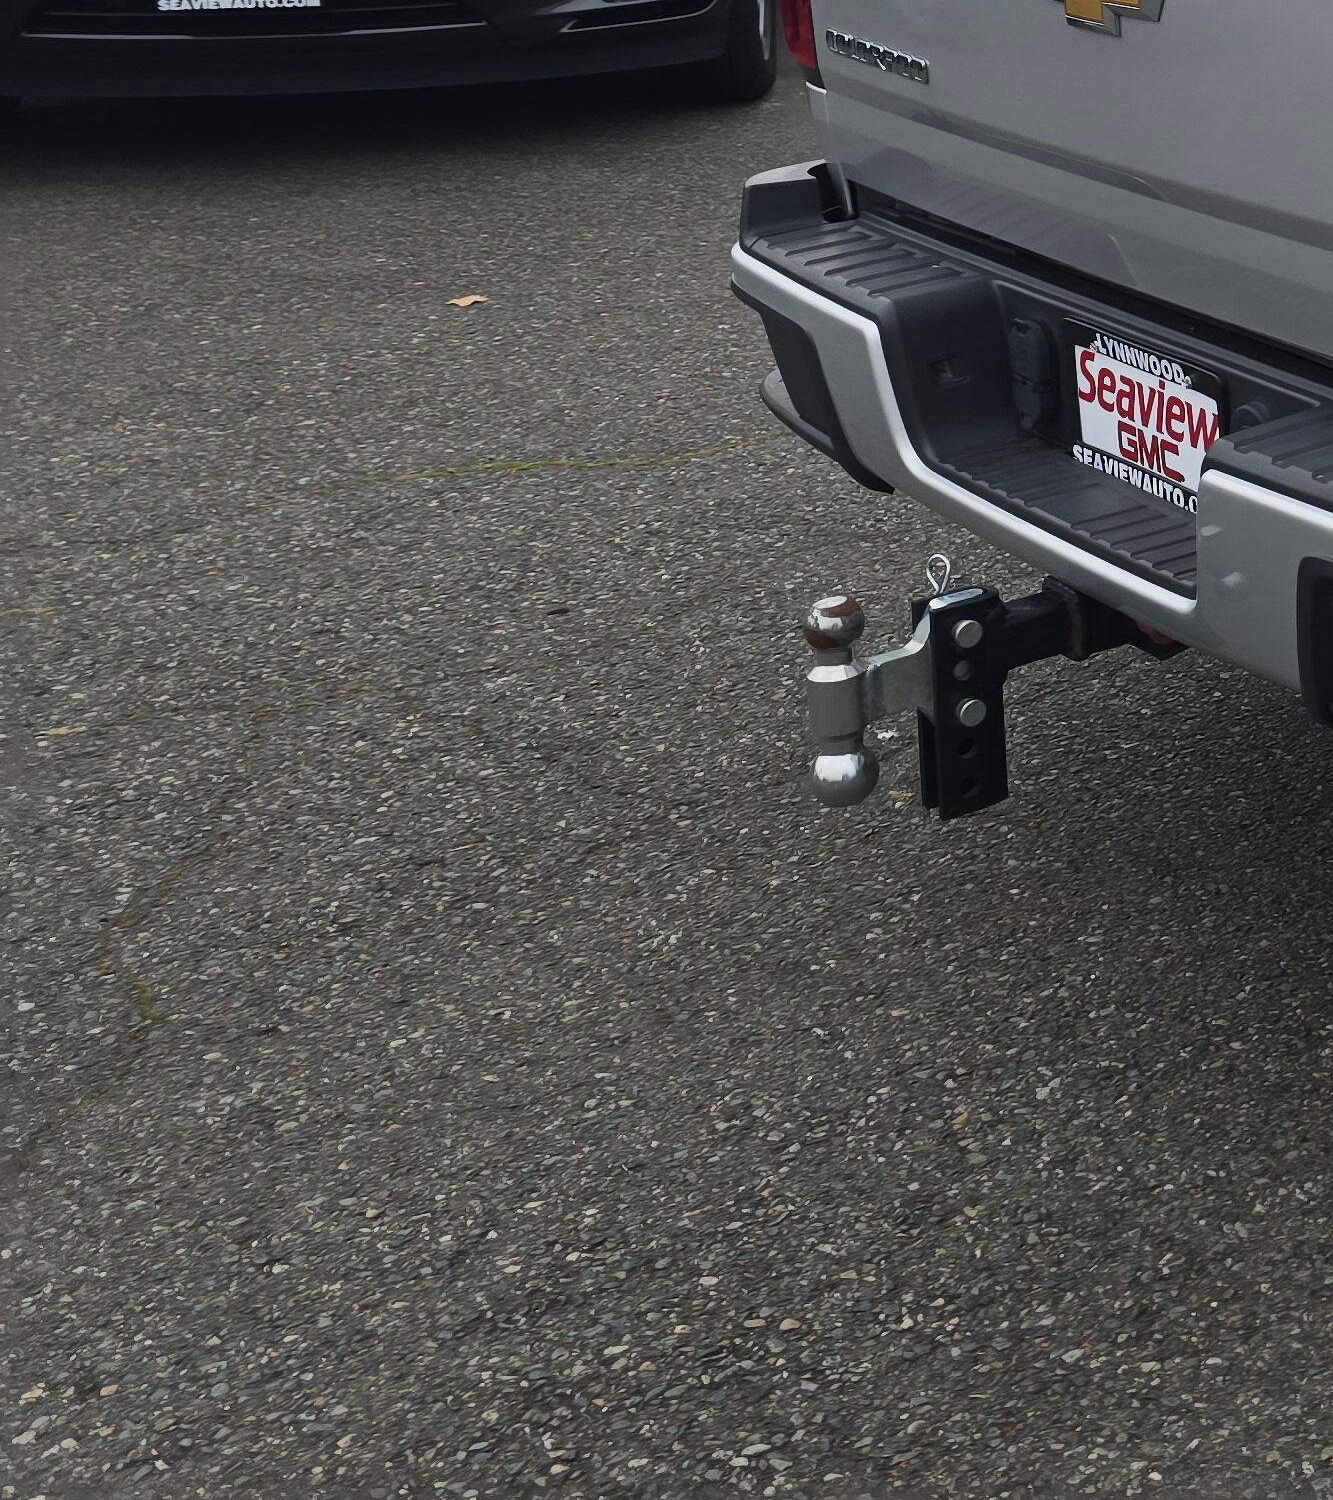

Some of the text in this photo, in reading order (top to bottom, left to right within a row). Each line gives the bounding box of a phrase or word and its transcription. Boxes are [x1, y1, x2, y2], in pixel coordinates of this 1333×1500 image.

[1095, 332, 1185, 386] LYNNWOOD
[1078, 349, 1221, 453] Seaview
[1117, 420, 1186, 484] GMC
